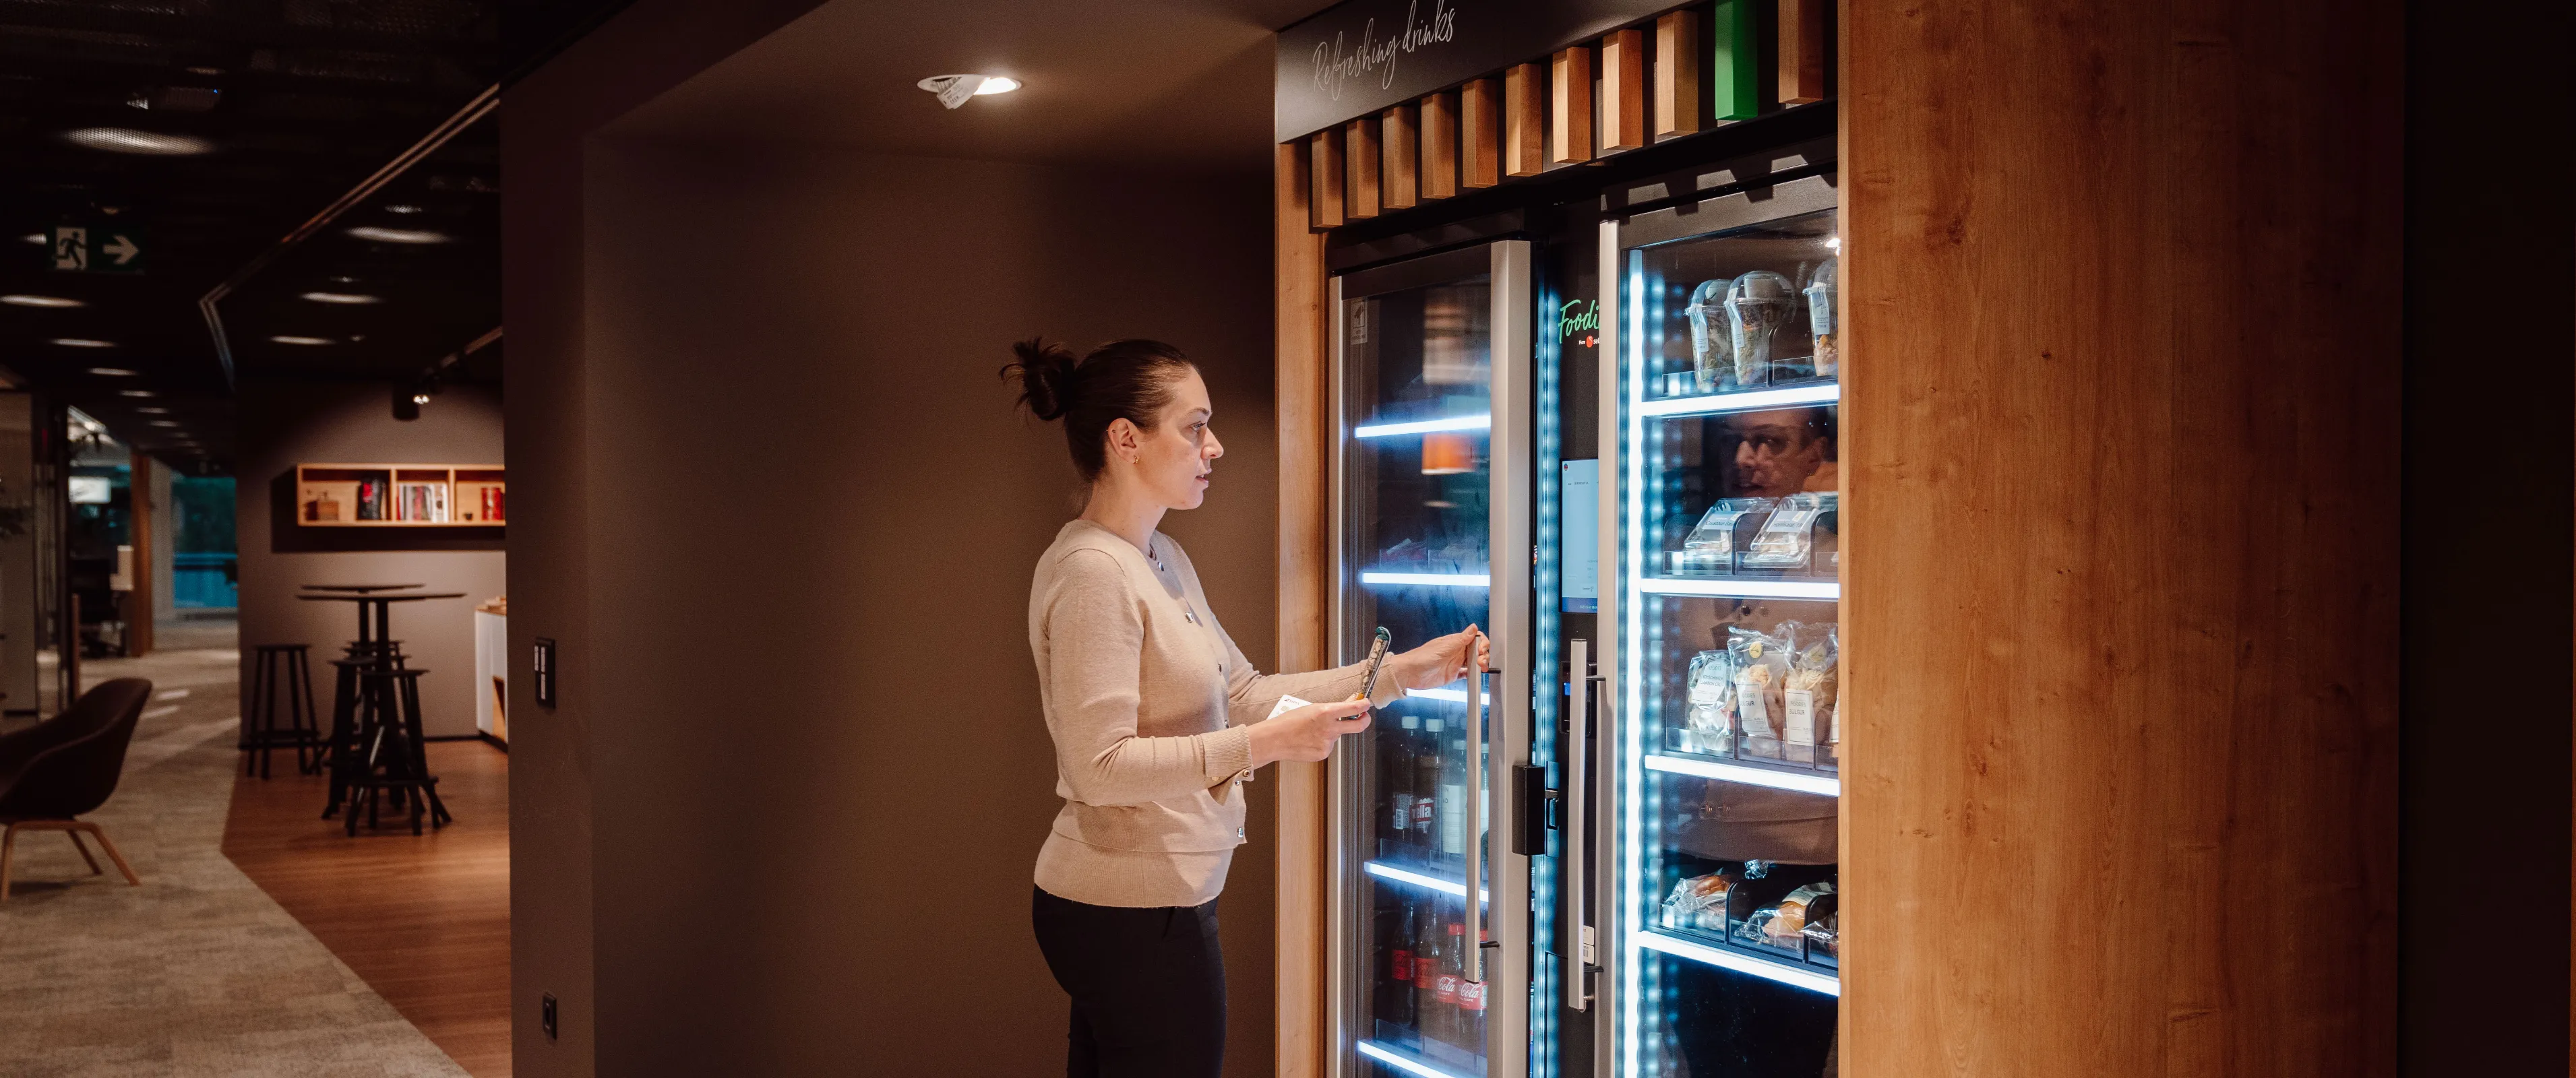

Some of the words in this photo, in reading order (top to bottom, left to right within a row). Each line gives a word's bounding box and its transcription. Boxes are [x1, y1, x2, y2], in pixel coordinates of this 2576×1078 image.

[1313, 18, 1401, 100] Refreshing
[1402, 0, 1456, 53] drinks
[1438, 976, 1457, 992] Cola
[1461, 982, 1481, 998] Cola
